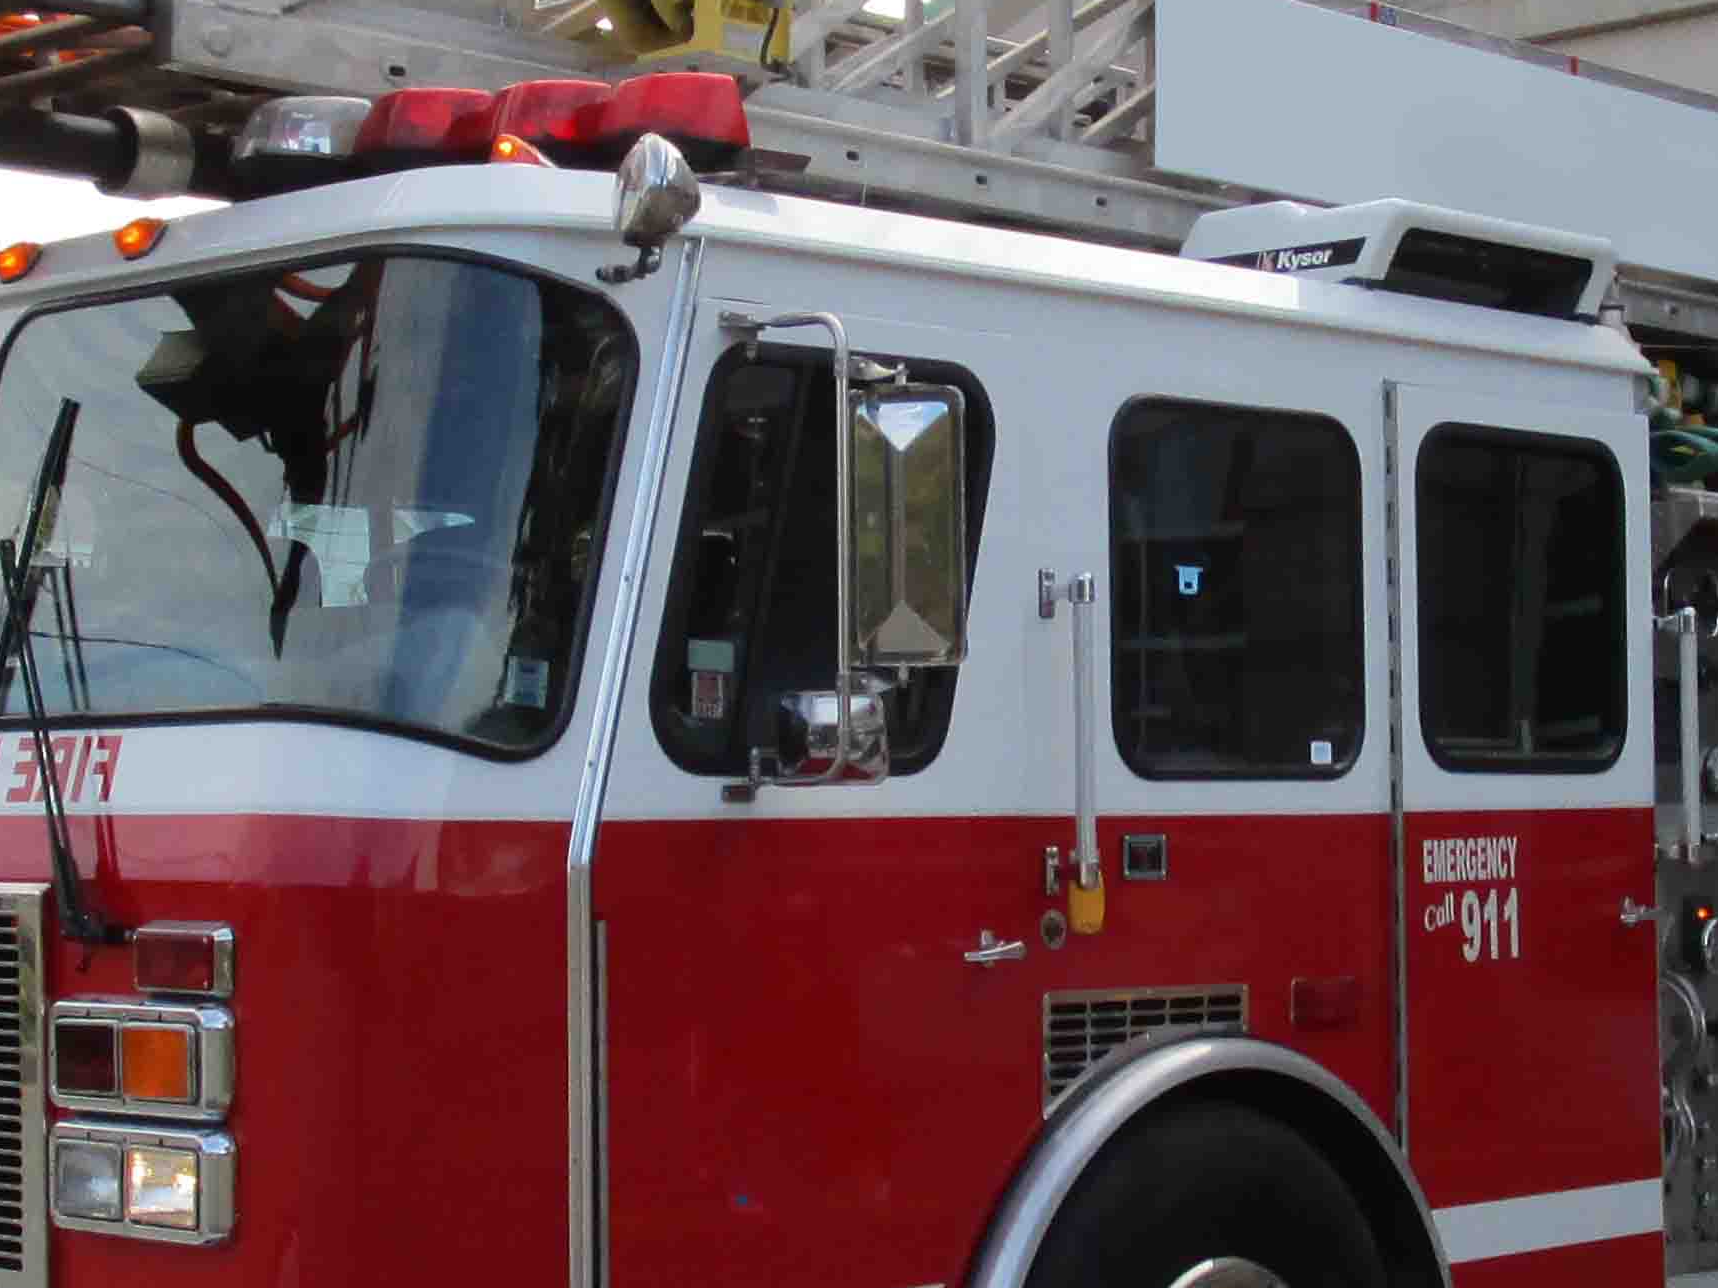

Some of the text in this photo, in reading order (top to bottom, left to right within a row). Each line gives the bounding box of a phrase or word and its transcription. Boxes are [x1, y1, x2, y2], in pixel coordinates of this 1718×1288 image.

[1277, 248, 1334, 271] Kysor
[1423, 836, 1517, 883] EMERGENCY
[1461, 887, 1519, 962] 911
